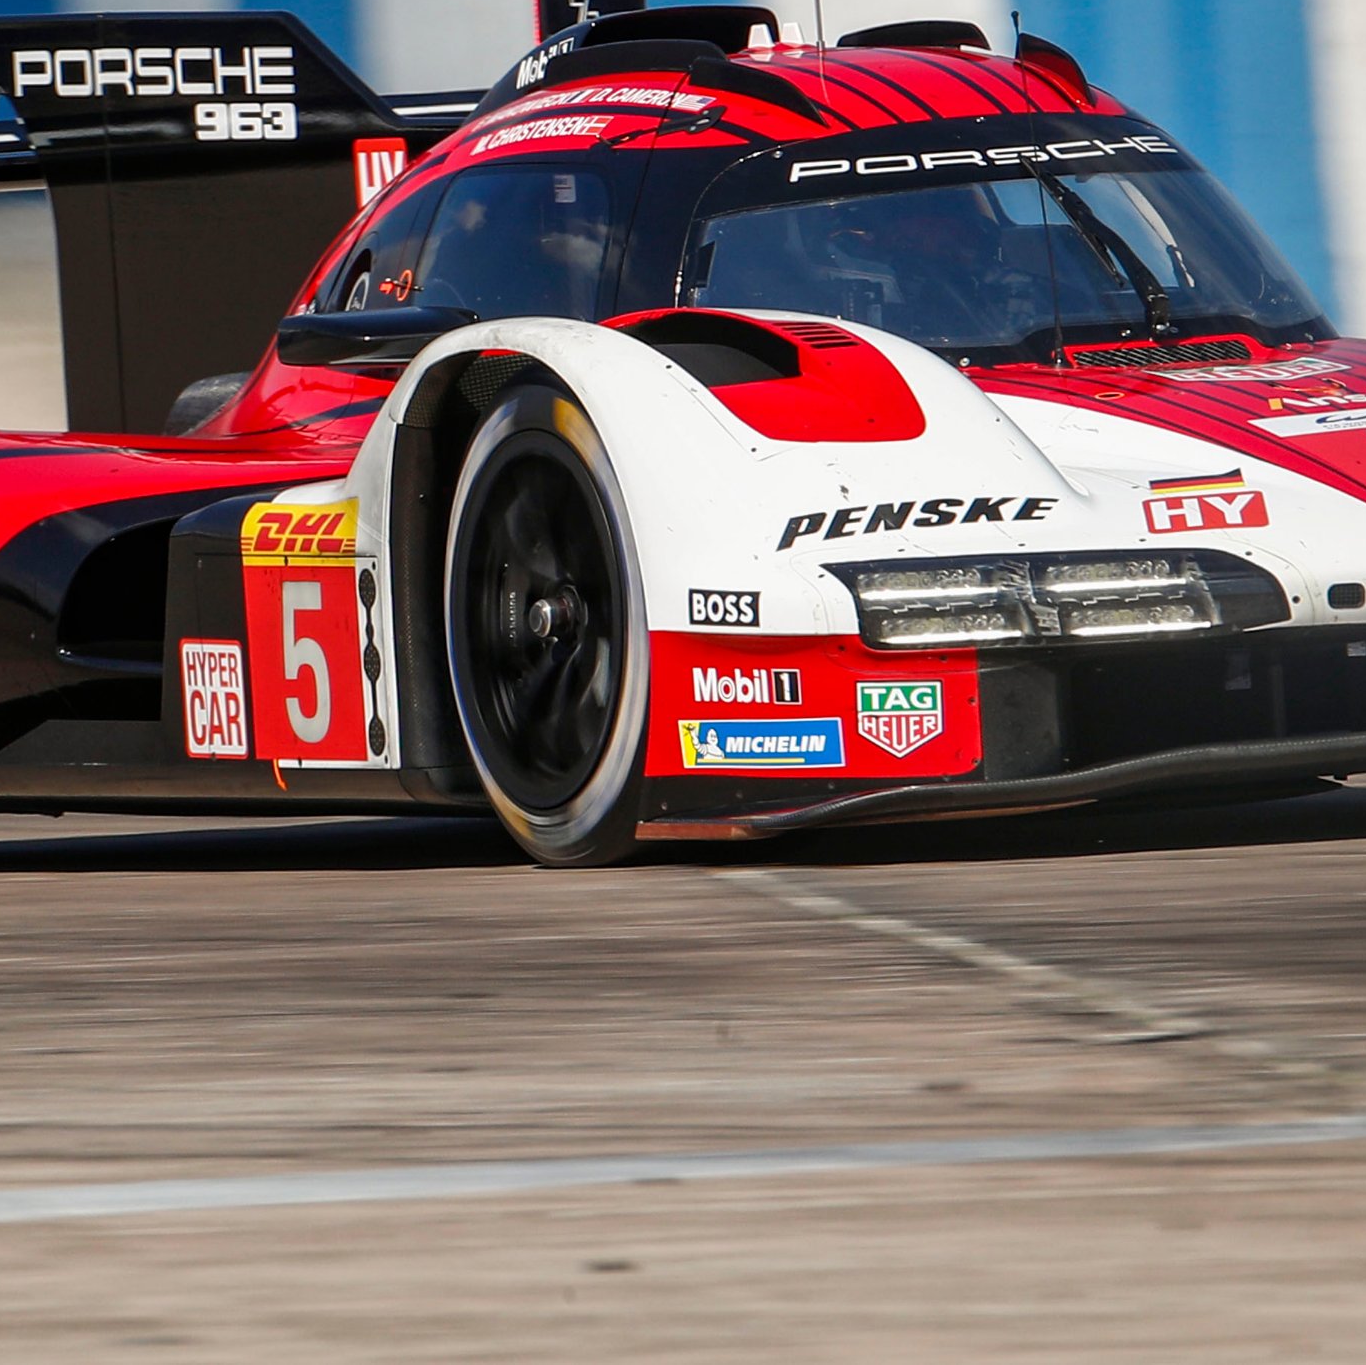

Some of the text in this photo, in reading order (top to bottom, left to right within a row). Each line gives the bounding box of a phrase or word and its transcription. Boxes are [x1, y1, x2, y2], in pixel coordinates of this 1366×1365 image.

[12, 47, 296, 97] PORSCHE
[607, 88, 687, 110] CAMERON
[195, 102, 297, 140] 963
[487, 115, 591, 151] CHRISTENSEN
[789, 136, 1177, 183] PORSCHE
[776, 497, 1059, 552] PENSKE
[1148, 496, 1254, 529] HY
[253, 512, 345, 552] DHL
[692, 592, 755, 624] BOSS
[186, 651, 240, 688] HYPER
[282, 581, 331, 744] 5
[692, 667, 770, 704] Mobil
[863, 687, 934, 711] TAG
[189, 690, 244, 746] CAR
[863, 714, 937, 751] HEUER
[725, 735, 826, 754] MICHELIN
